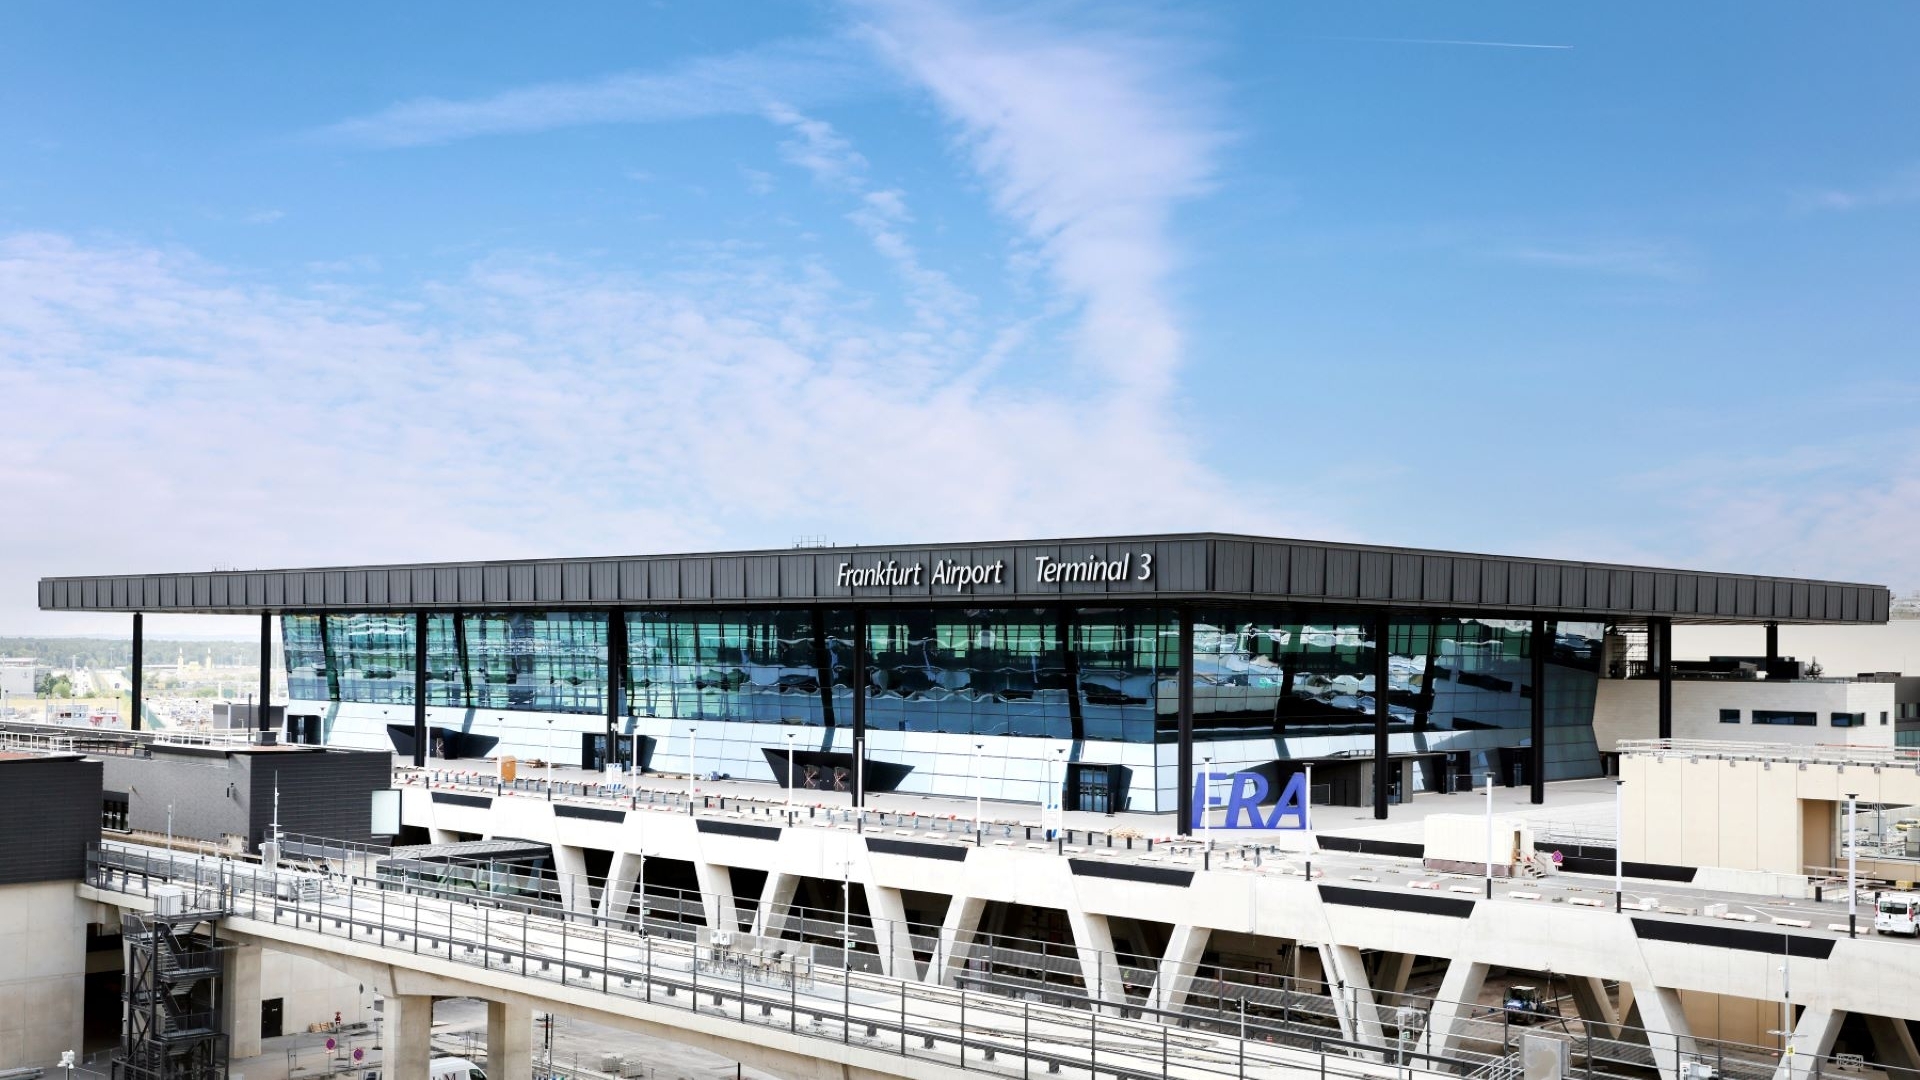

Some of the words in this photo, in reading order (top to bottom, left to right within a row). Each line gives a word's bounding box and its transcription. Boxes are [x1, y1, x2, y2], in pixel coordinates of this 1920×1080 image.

[836, 560, 922, 587] Frankfurt
[931, 559, 1004, 592] Airport
[1035, 553, 1131, 583] Terminal
[1137, 553, 1153, 581] 3
[1191, 772, 1312, 830] FRA
